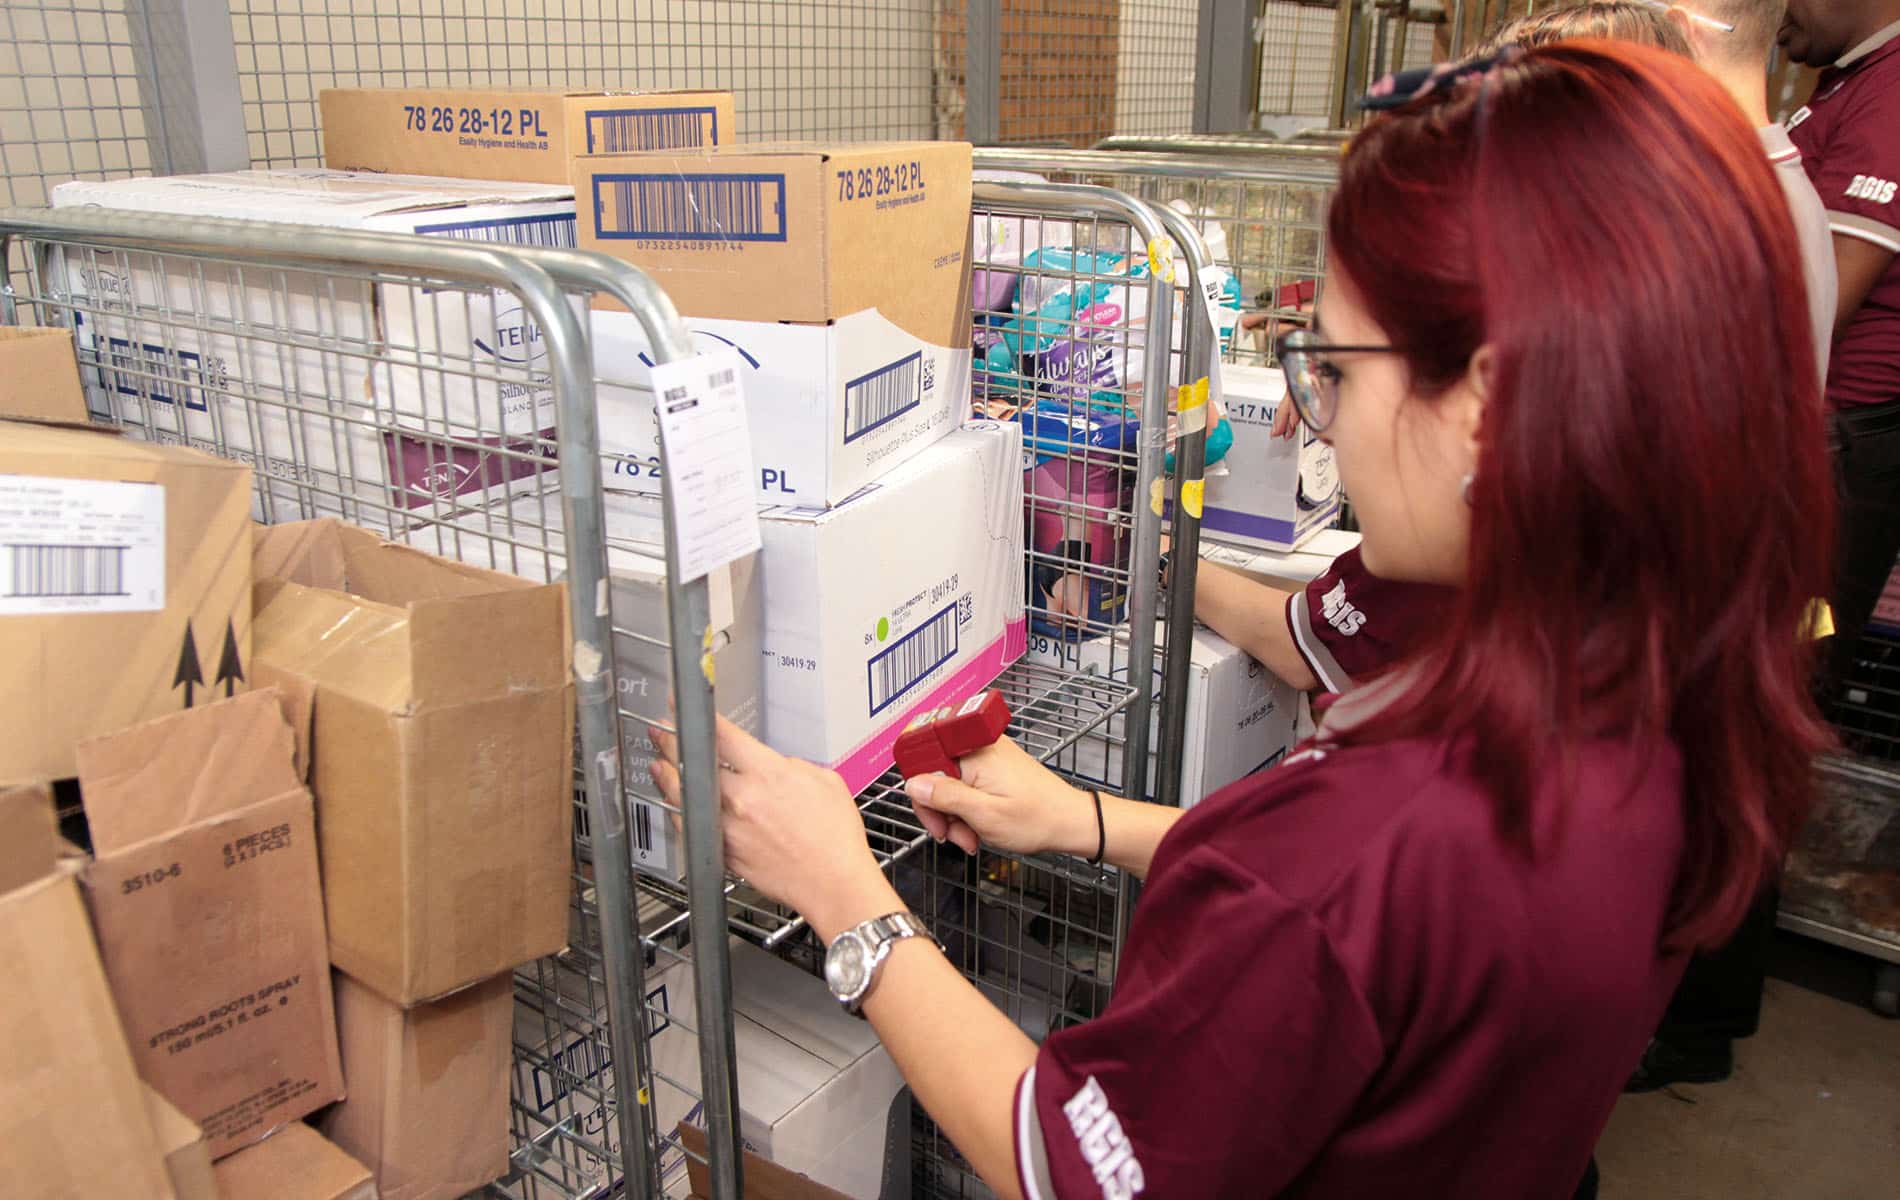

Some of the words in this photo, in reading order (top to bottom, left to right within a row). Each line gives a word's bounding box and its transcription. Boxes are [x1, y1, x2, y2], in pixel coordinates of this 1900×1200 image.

[404, 106, 426, 131] 78
[431, 107, 454, 133] 26
[459, 108, 512, 135] 28-12
[519, 110, 548, 137] PL
[504, 140, 515, 148] and
[516, 141, 537, 150] Health
[837, 170, 854, 202] 78
[857, 168, 873, 198] 26
[876, 164, 908, 195] 28-12
[910, 161, 925, 190] PL
[1844, 174, 1898, 204] RGIS
[1225, 401, 1256, 418] -17
[648, 457, 663, 478] 2
[761, 468, 796, 493] PL
[235, 823, 291, 850] PIECES
[149, 1015, 206, 1048] STRONG
[208, 994, 256, 1022] ROOTS
[257, 974, 300, 1000] SPRAY
[1063, 1074, 1145, 1200] RGIS
